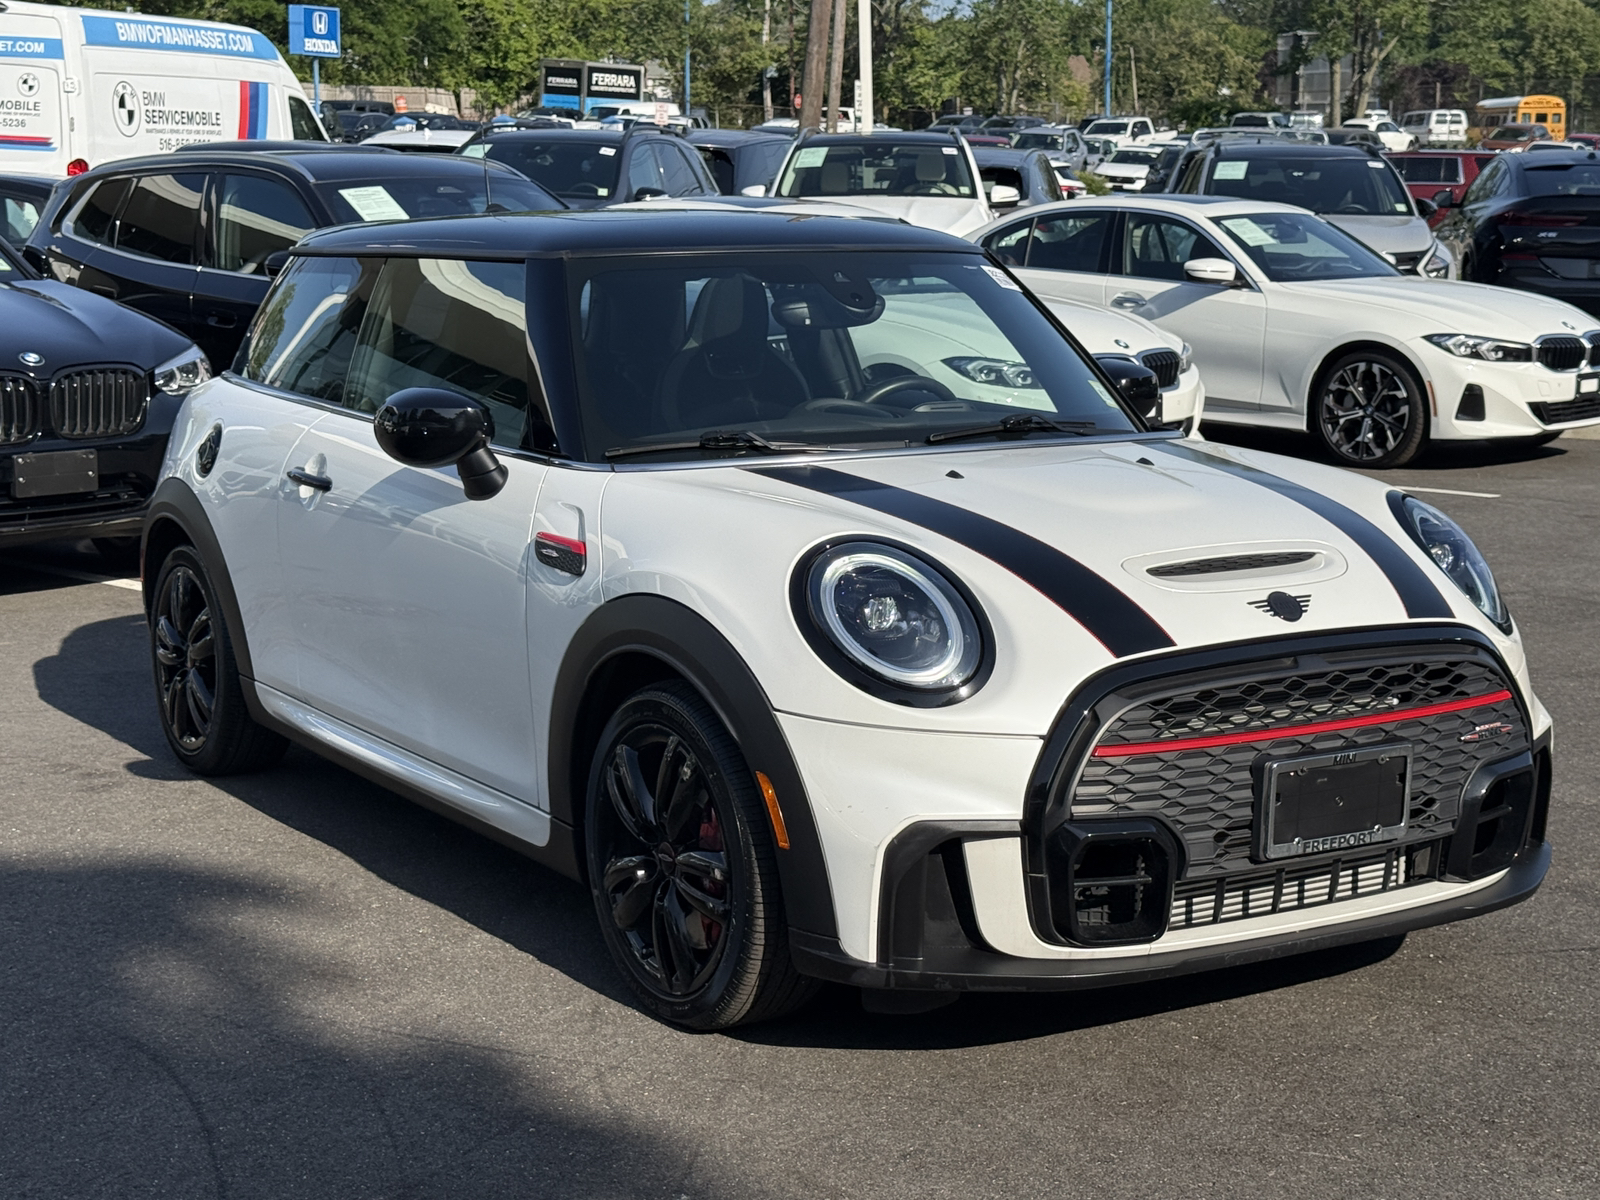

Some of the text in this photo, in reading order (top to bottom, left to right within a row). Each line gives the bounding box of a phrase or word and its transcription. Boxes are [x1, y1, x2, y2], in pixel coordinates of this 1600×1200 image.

[115, 22, 254, 53] BMWOFMANHASSET.COM
[304, 38, 338, 54] HONDA
[592, 73, 636, 87] FERRARA
[142, 91, 165, 107] BMW
[144, 109, 221, 126] SERVICEMOBILE
[1332, 752, 1357, 766] MINI
[1302, 831, 1376, 853] FREEPORT
